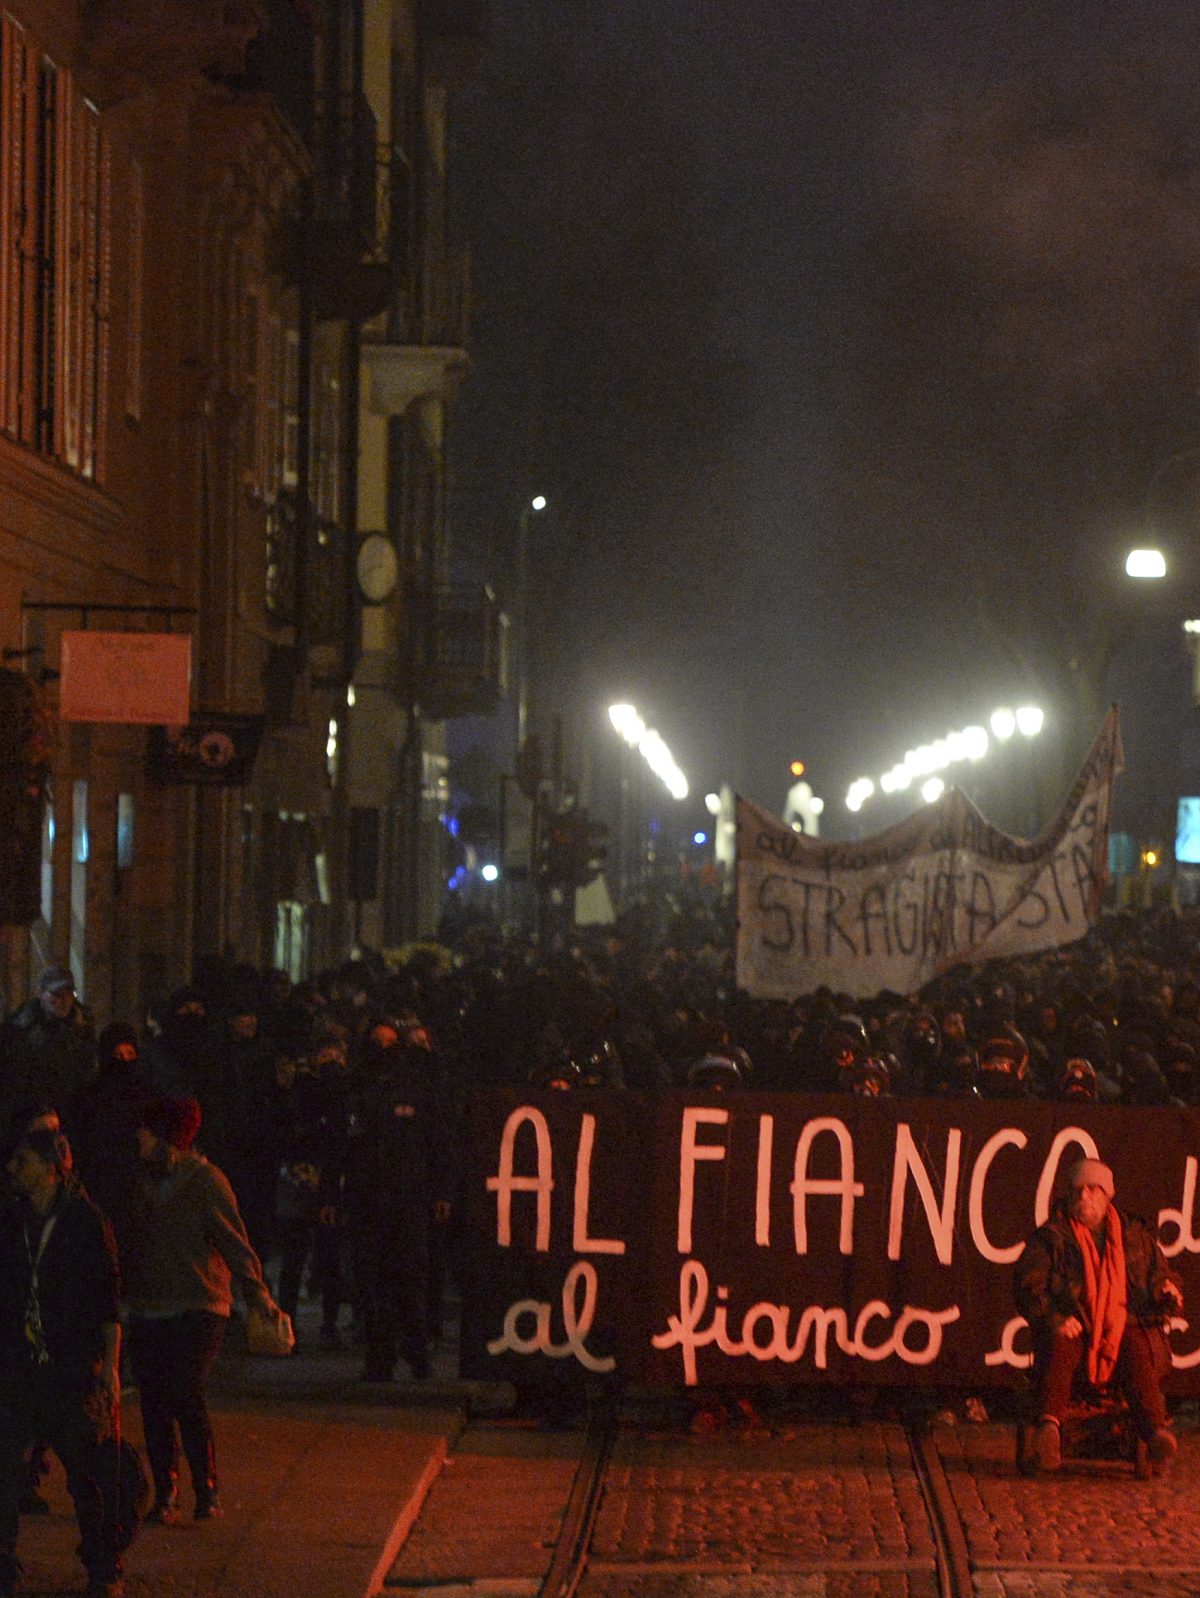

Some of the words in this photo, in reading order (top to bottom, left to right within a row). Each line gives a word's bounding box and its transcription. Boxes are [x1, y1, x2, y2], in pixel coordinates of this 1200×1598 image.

[486, 1105, 626, 1254] AL
[487, 1260, 616, 1372] al
[652, 1259, 960, 1386] fianco
